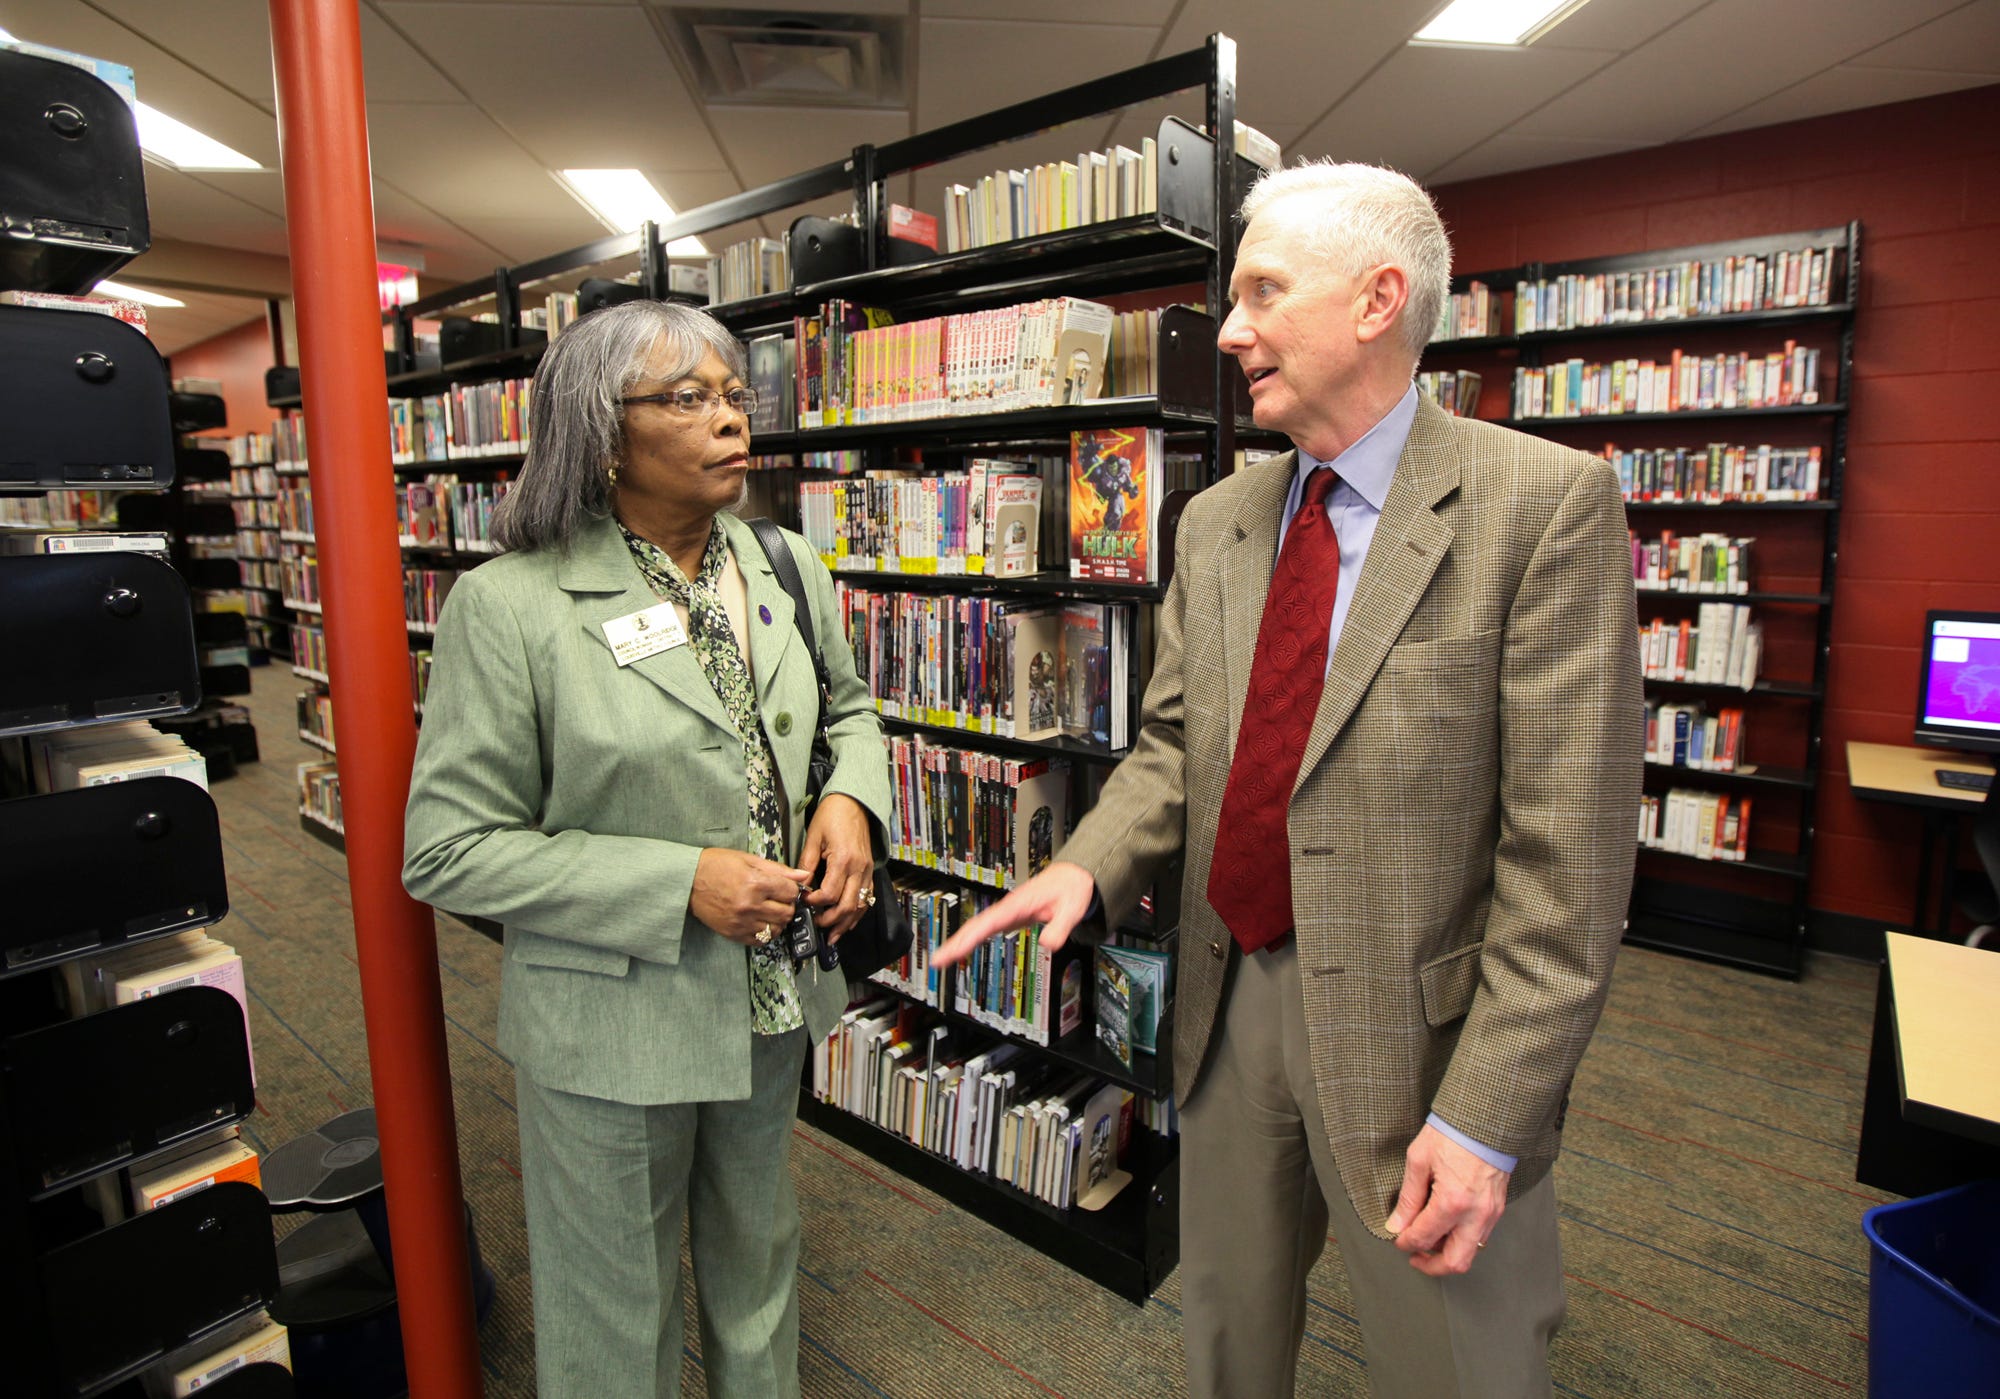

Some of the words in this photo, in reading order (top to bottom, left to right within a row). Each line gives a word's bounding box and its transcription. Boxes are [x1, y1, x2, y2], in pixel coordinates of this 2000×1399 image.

[1082, 535, 1138, 559] HULK
[615, 640, 632, 650] MARY
[1035, 973, 1043, 1007] CUISINE
